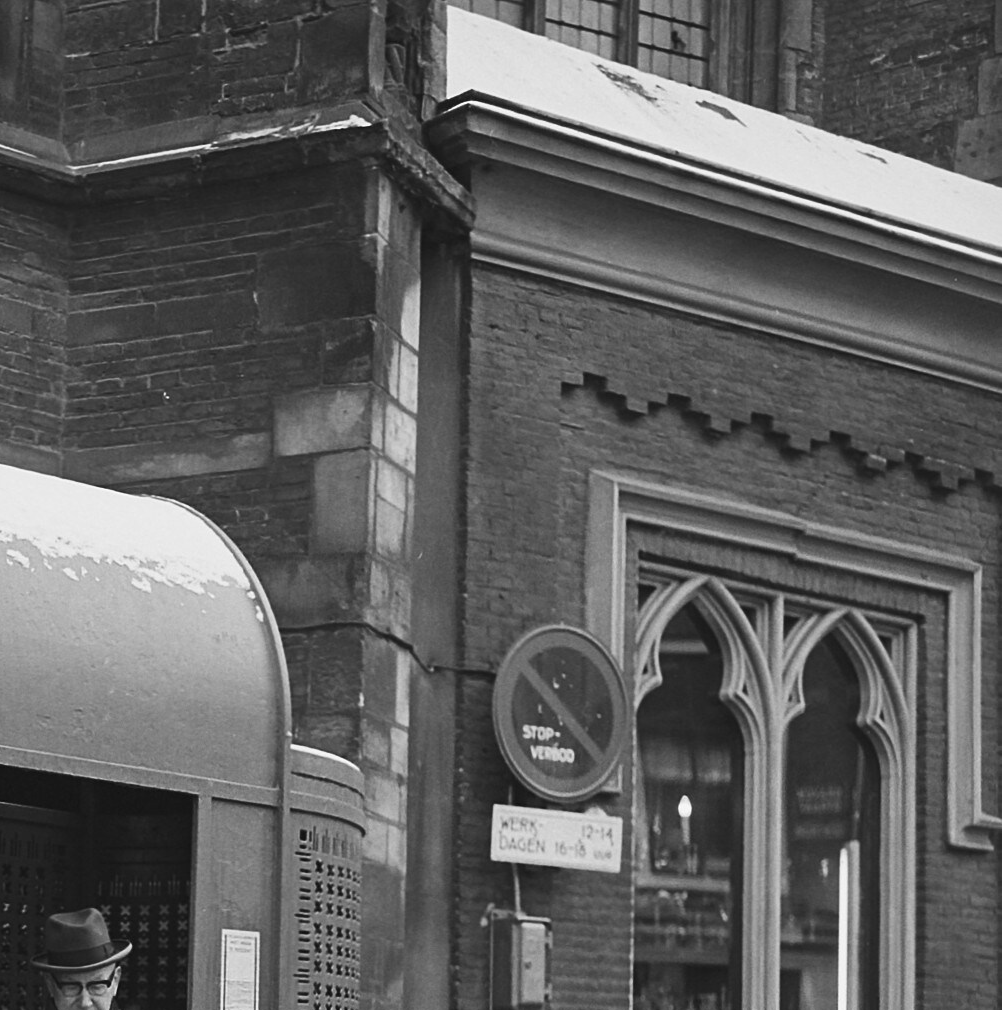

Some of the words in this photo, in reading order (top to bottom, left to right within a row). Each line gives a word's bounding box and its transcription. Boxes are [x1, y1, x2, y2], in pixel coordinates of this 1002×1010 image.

[530, 744, 575, 764] VERBOD
[581, 824, 613, 843] 12-14
[499, 835, 545, 853] DAGEN
[555, 841, 587, 857] 16-18
